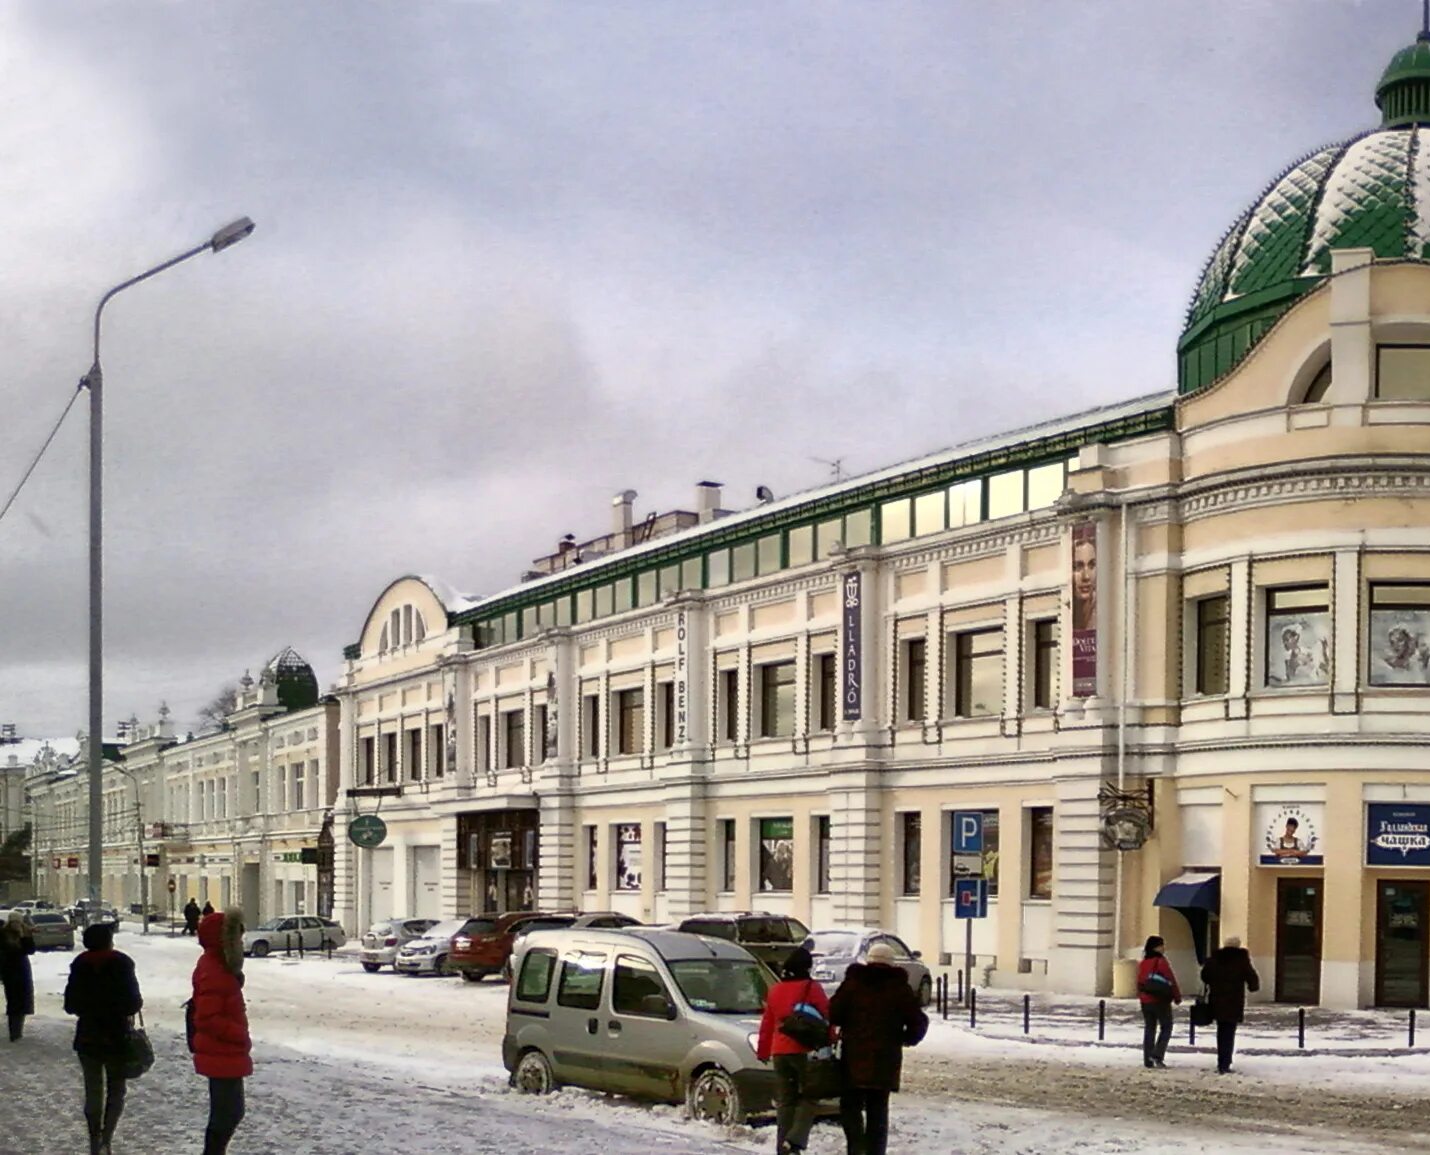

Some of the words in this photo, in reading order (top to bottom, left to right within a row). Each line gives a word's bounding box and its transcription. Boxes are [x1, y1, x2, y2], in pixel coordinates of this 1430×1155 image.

[677, 612, 686, 672] ROLF
[846, 614, 860, 705] LLADRÓ
[677, 680, 686, 739] BENZ
[961, 816, 979, 849] P
